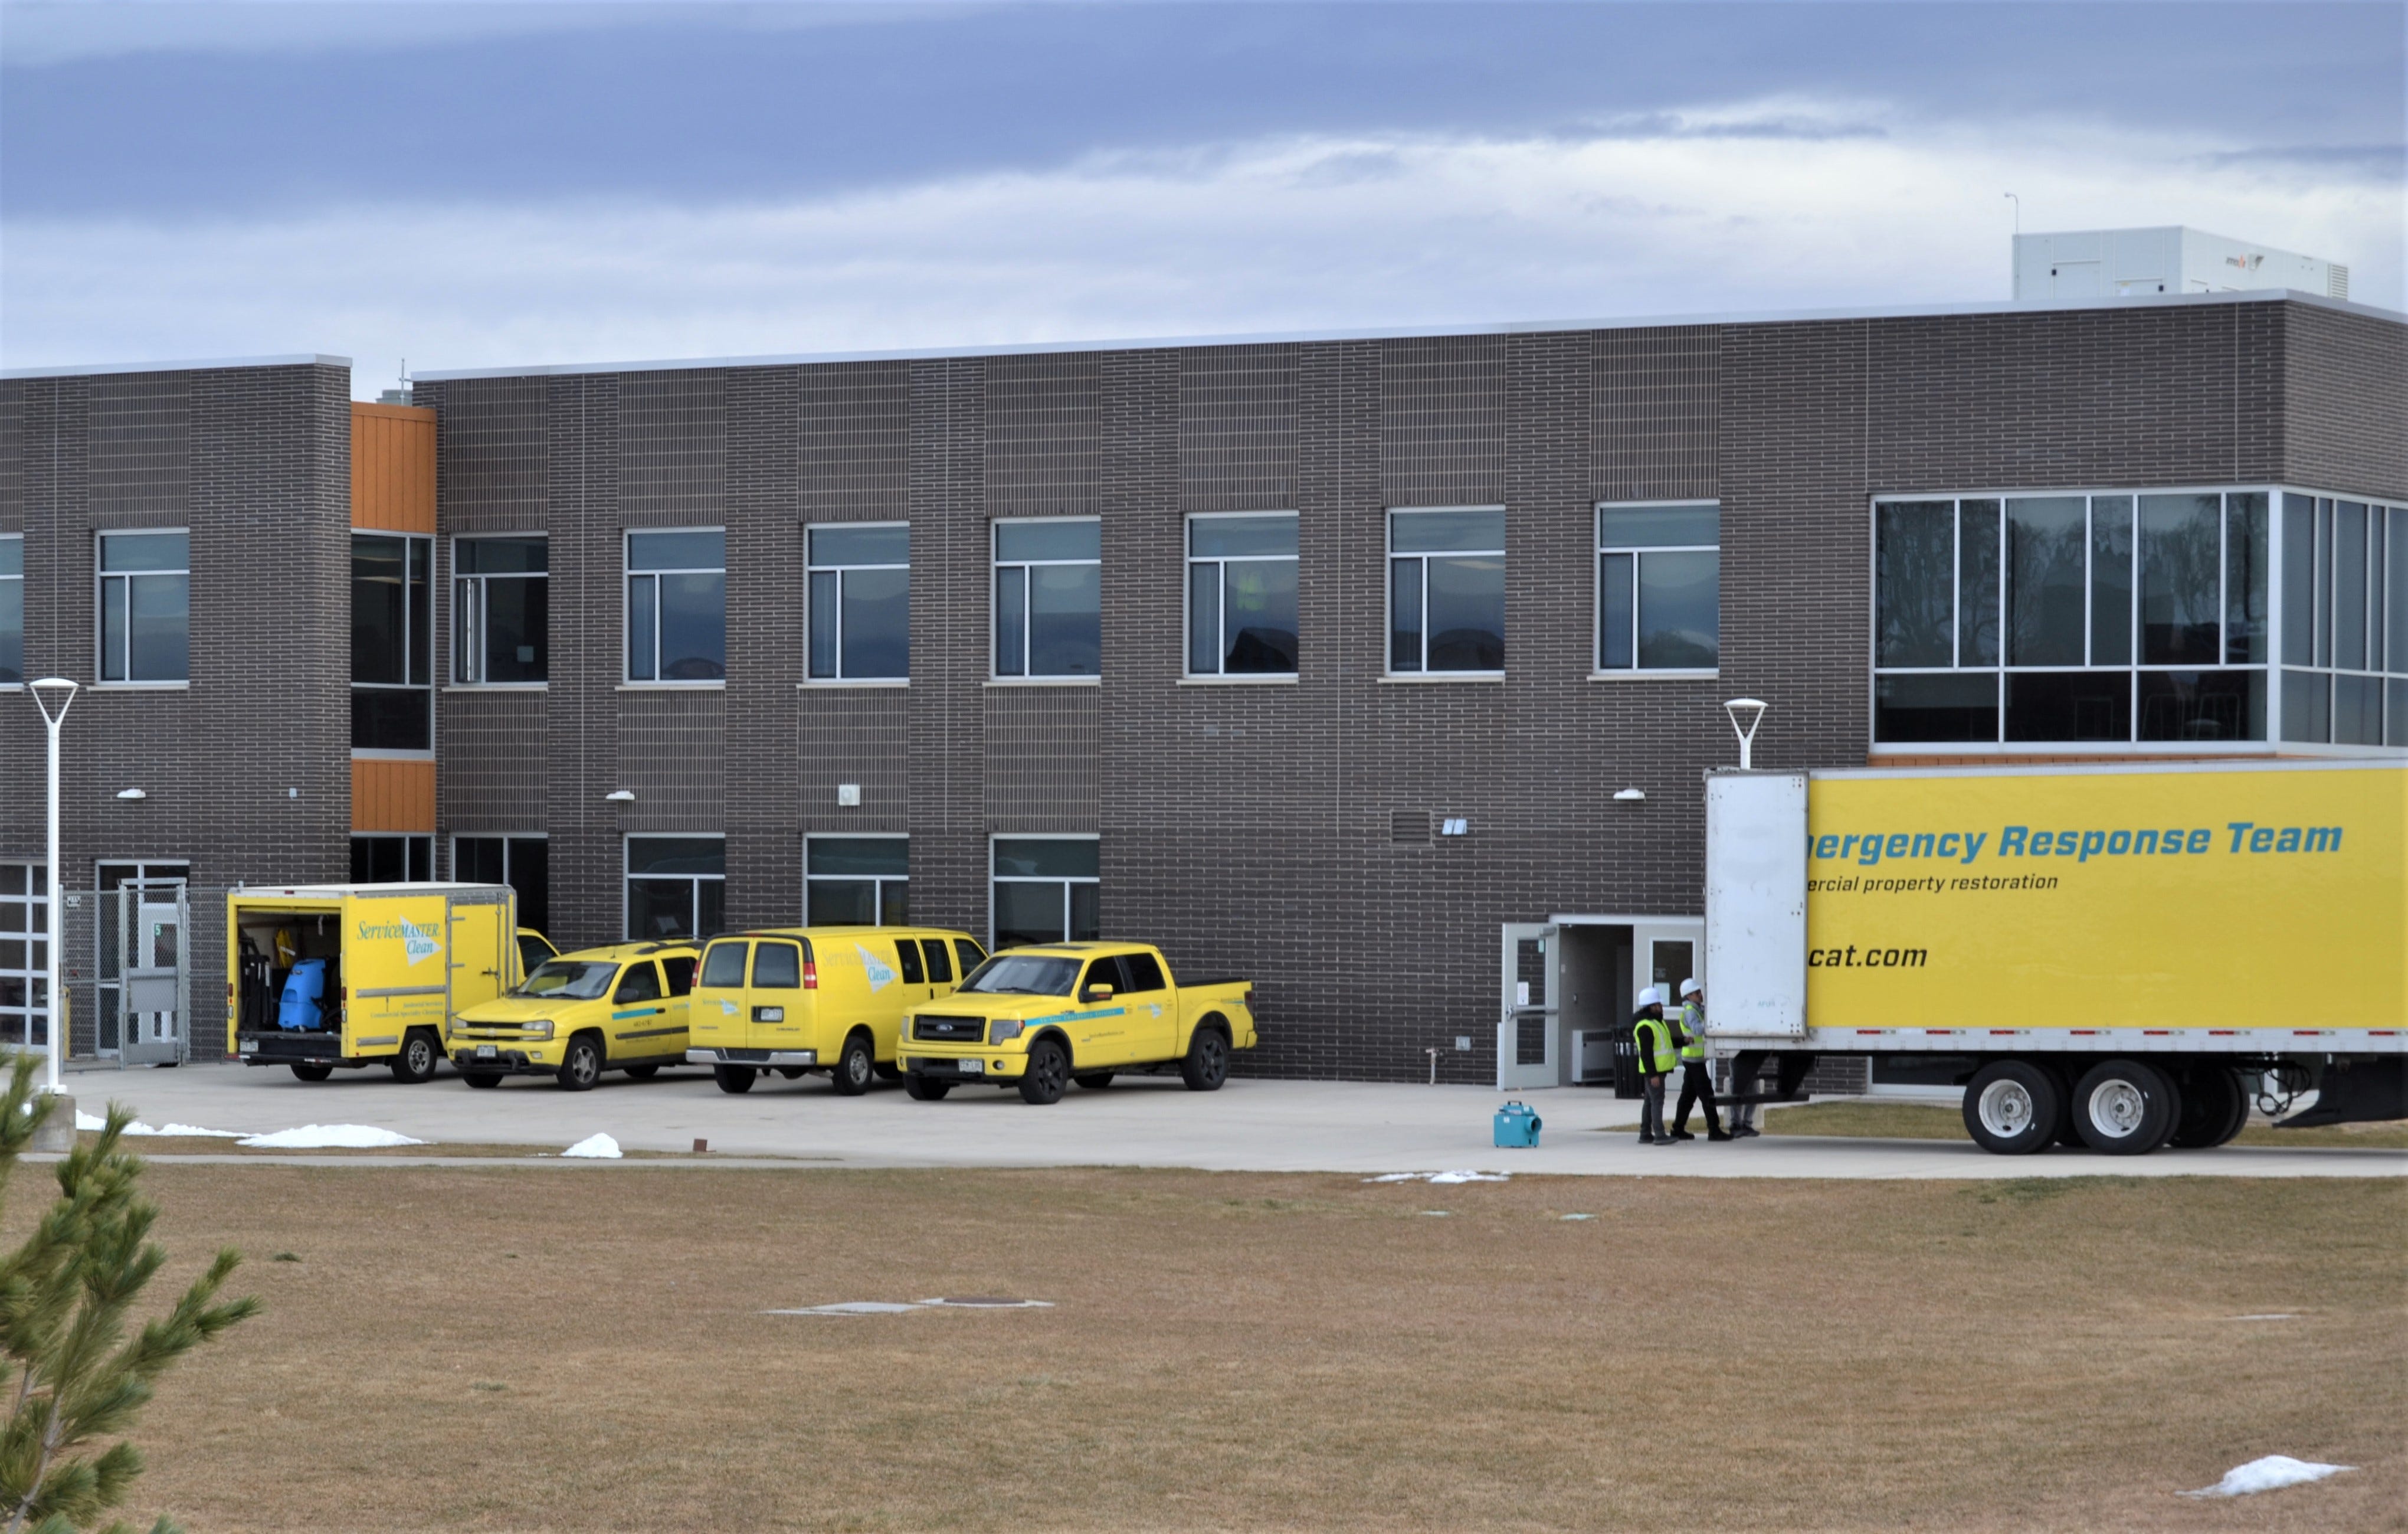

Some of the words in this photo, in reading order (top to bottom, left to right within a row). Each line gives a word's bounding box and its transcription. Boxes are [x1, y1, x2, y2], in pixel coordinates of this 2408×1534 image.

[1998, 825, 2212, 863] Response
[2227, 822, 2343, 853] Team
[1863, 876, 1945, 894] property
[1950, 873, 2058, 890] restoration
[155, 924, 161, 936] 5
[407, 939, 433, 954] Clean
[1808, 945, 1928, 967] cat.com
[868, 966, 890, 982] Clean
